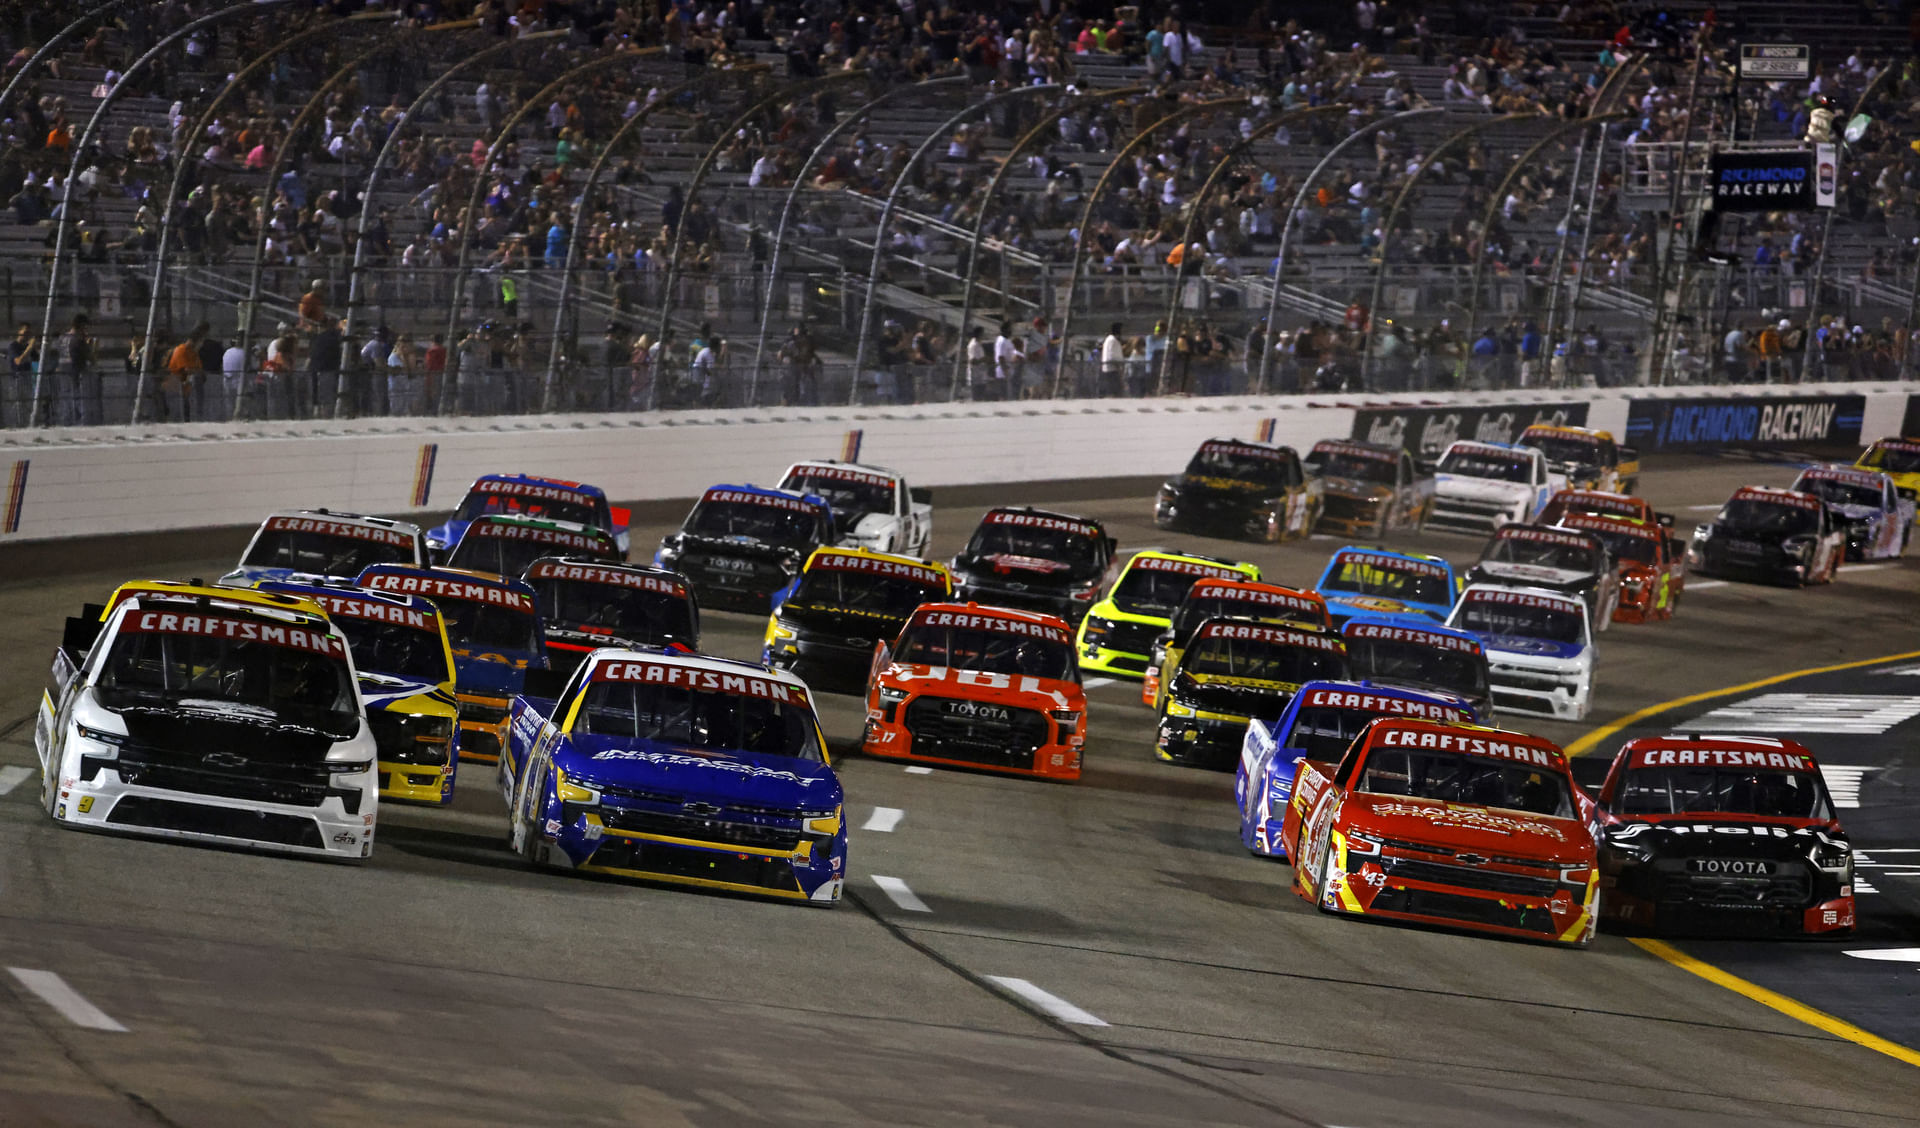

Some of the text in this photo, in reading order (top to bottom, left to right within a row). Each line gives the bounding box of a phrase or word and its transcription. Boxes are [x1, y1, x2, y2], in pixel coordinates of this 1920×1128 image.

[1721, 167, 1806, 181] RICHMOND
[1718, 182, 1803, 195] RACEWAY
[1668, 403, 1836, 442] RICHMOND RACEWAY
[797, 467, 889, 486] CRAFTSMAN
[480, 481, 584, 504] CRAFTSMAN
[711, 491, 812, 513] CRAFTSMAN
[274, 518, 401, 545] CRAFTSMAN
[993, 513, 1091, 536] CRAFTSMAN
[480, 525, 600, 550] CRAFTSMAN
[1502, 529, 1590, 547] CRAFTSMAN
[709, 556, 753, 571] TOYOTA
[822, 556, 938, 582] CRAFTSMAN
[1344, 554, 1441, 576] CRAFTSMAN
[541, 564, 674, 594] CRAFTSMAN
[369, 575, 519, 607] CRAFTSMAN
[1200, 586, 1313, 611] CRAFTSMAN
[1473, 591, 1575, 613] CRAFTSMAN
[140, 613, 330, 653] CRAFTSMAN
[925, 613, 1060, 641] CRAFTSMAN
[1210, 625, 1334, 650] CRAFTSMAN
[1355, 625, 1471, 652] CRAFTSMAN
[605, 663, 789, 701] CRAFTSMAN
[949, 703, 1009, 720] TOYOTA
[1313, 692, 1461, 723] CRAFTSMAN
[882, 731, 896, 743] 17
[1384, 730, 1549, 766] CRAFTSMAN
[1644, 750, 1804, 769] CRAFTSMAN
[78, 796, 95, 813] 9
[1365, 872, 1387, 886] 43
[1696, 860, 1768, 875] TOYOTA
